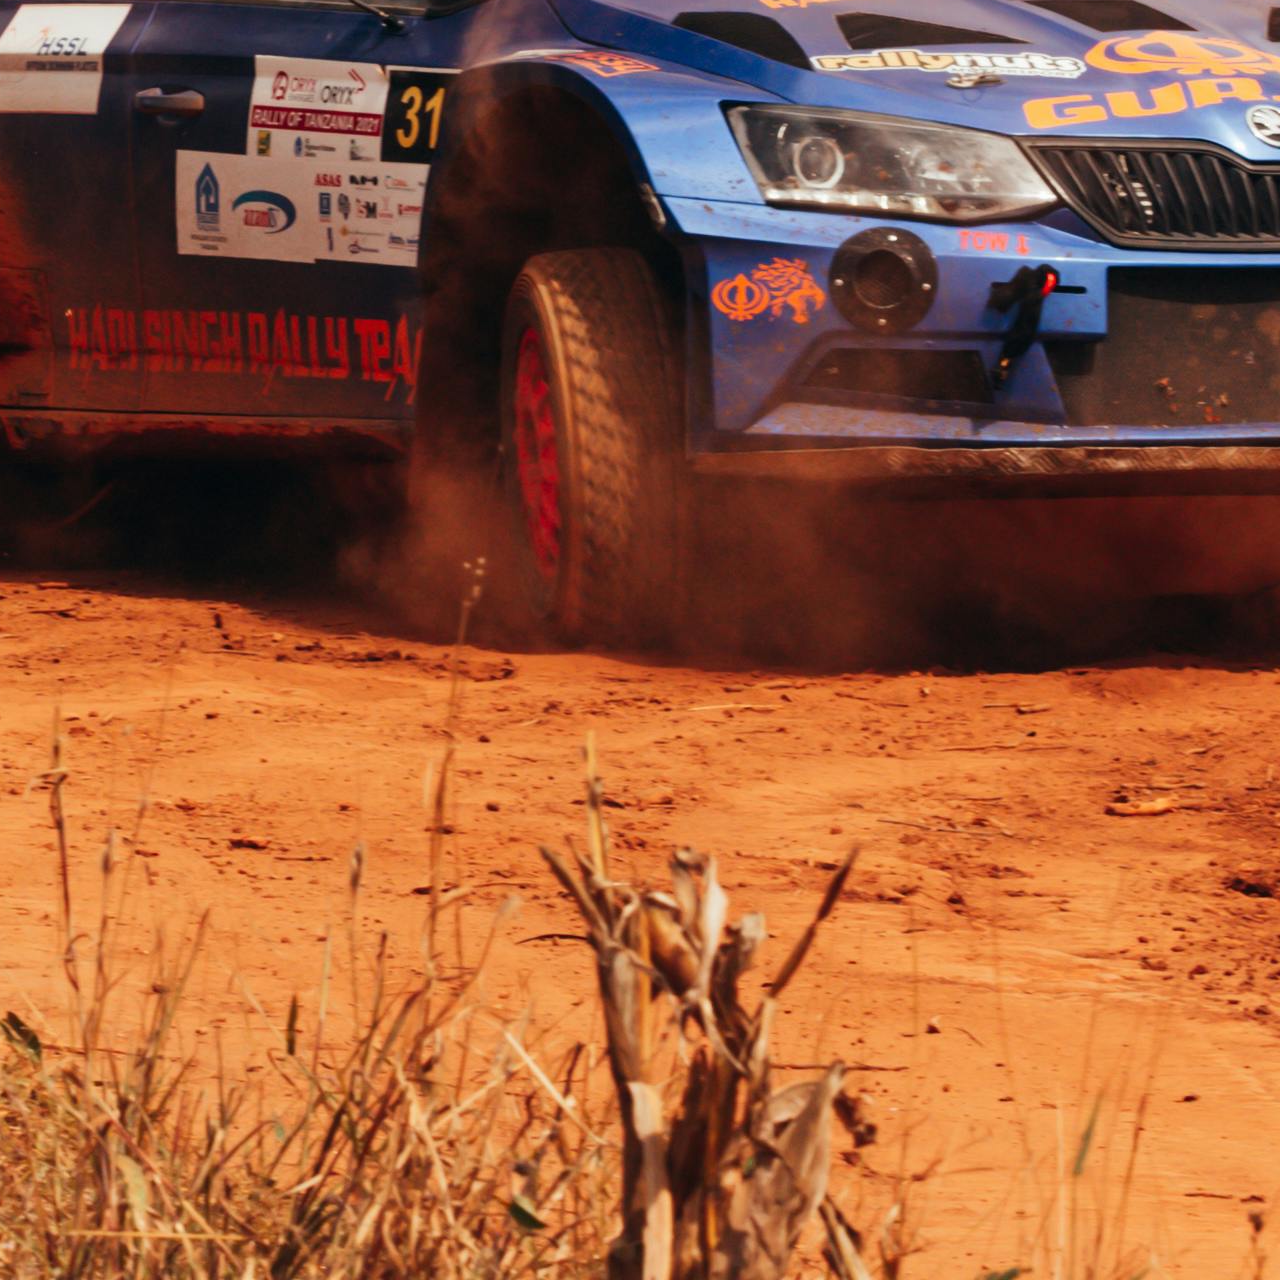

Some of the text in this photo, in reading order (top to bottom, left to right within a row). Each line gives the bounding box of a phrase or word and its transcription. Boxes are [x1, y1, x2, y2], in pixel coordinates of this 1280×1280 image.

[36, 36, 88, 57] HSSL
[818, 50, 1084, 72] rallynuts
[320, 85, 355, 106] ORYX
[252, 108, 288, 126] RALLY
[287, 111, 304, 128] OF
[303, 112, 355, 131] TANZANIA
[396, 85, 446, 150] 31
[958, 228, 1010, 252] TOW
